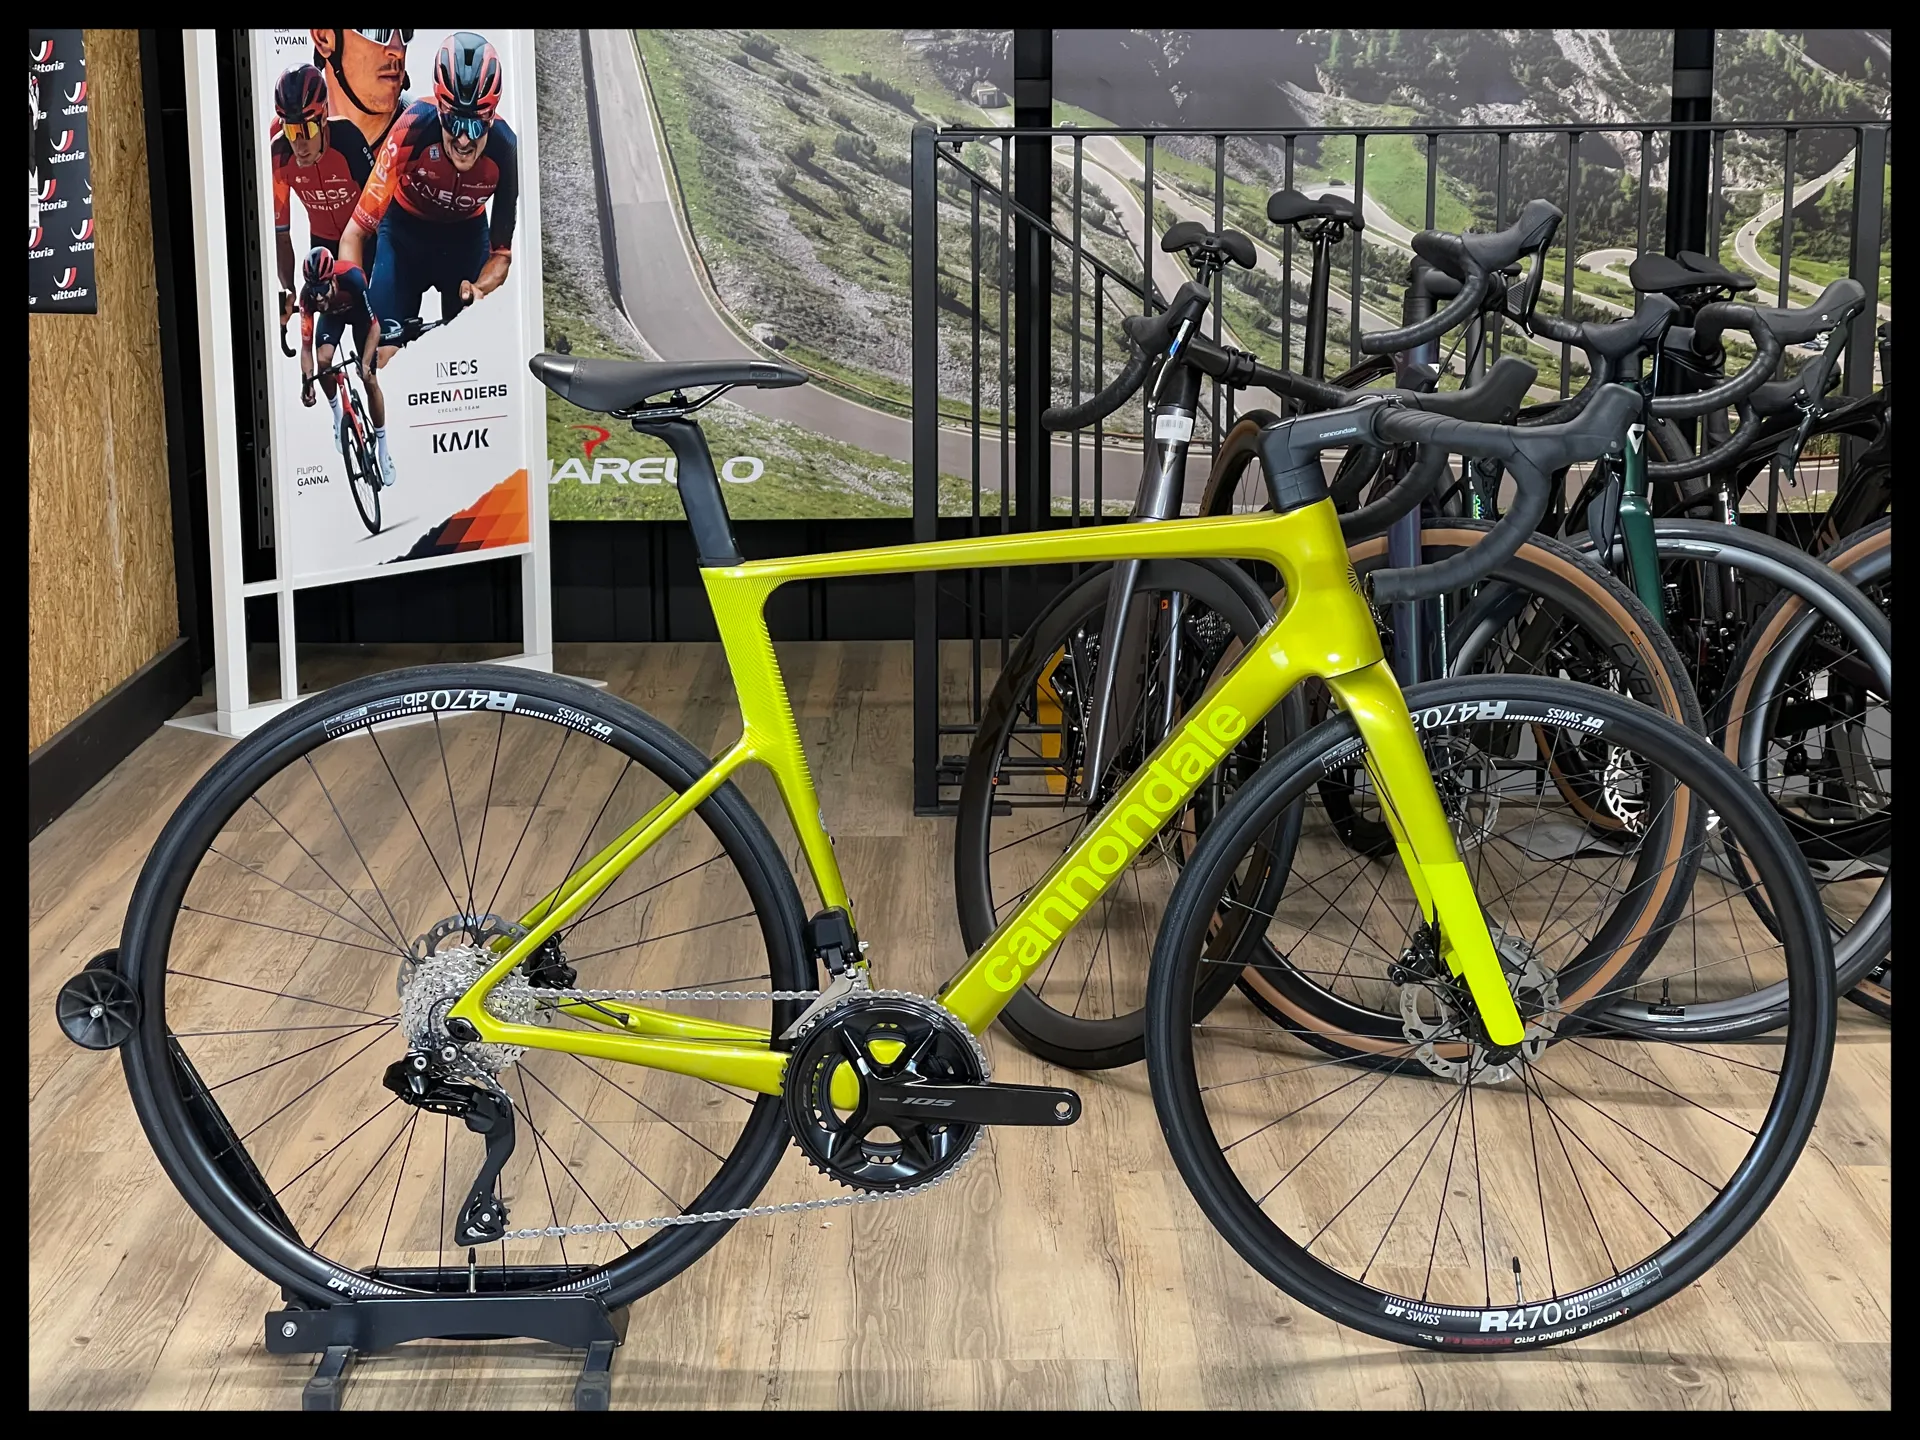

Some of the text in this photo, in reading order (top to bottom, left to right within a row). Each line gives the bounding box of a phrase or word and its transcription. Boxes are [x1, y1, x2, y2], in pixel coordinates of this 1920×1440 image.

[274, 36, 308, 45] VIVIANI
[48, 151, 84, 164] vittoria
[301, 187, 348, 201] INEOS
[51, 288, 87, 301] vittoria
[436, 359, 478, 378] INEOS
[408, 384, 507, 406] GRENADIERS
[437, 406, 462, 414] CYCLING
[1319, 427, 1357, 438] cannondale
[432, 427, 490, 454] KASK
[296, 464, 323, 476] FILIPPO
[297, 475, 330, 487] GANNA
[403, 689, 518, 712] R470 db
[557, 707, 614, 737] DT SWISS
[1422, 701, 1508, 729] R470
[1546, 707, 1605, 728] DT SWISS
[984, 705, 1247, 993] cannondale
[902, 1097, 957, 1108] 105
[327, 1277, 350, 1291] DT
[1384, 1305, 1441, 1326] DT SWISS
[1480, 1303, 1588, 1332] R470 db
[1514, 1335, 1536, 1345] PRO
[1538, 1327, 1576, 1342] RUBINO
